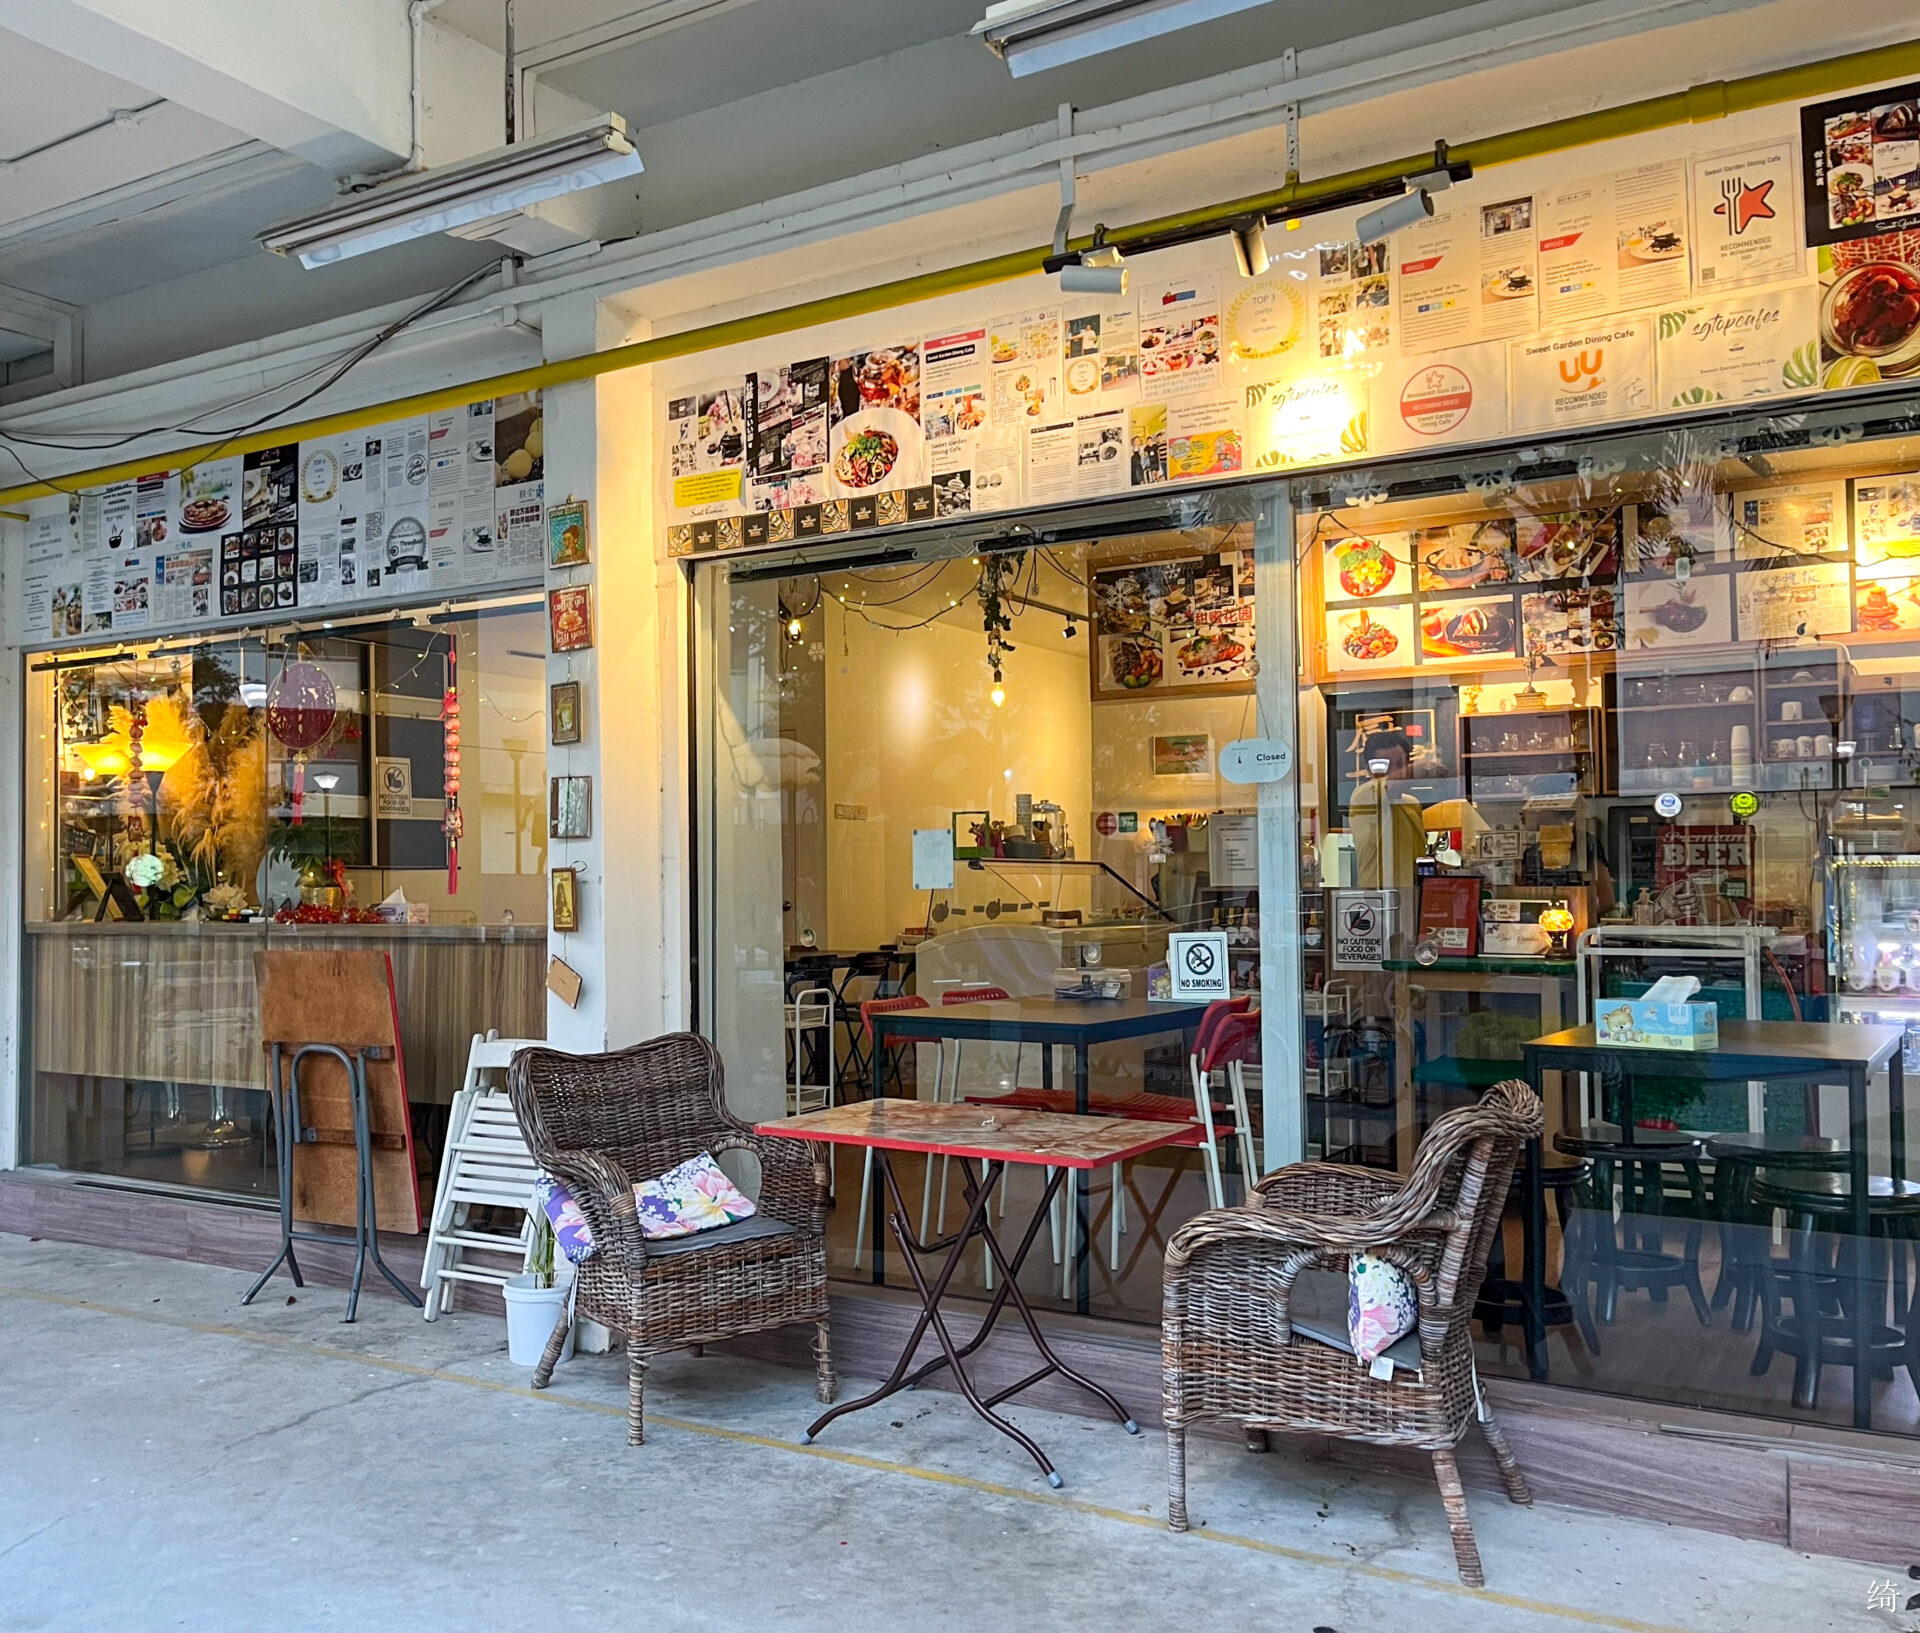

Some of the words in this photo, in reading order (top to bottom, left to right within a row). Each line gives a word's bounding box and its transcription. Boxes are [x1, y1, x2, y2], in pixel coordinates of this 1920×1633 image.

[1705, 168, 1723, 177] Sweet
[1724, 164, 1746, 173] Garden
[1747, 159, 1766, 168] Dining
[1720, 236, 1772, 252] RECOMMENDED
[1252, 295, 1270, 305] TOP
[1270, 294, 1276, 302] 3
[1691, 308, 1780, 342] sgtopcafes
[1526, 344, 1551, 356] Sweet
[1553, 340, 1584, 350] Garden
[1586, 334, 1612, 346] Dining
[1614, 330, 1634, 340] Cafe
[1161, 374, 1182, 382] Garden
[1182, 370, 1200, 380] Dining
[1200, 366, 1214, 375] Cafe
[1407, 390, 1436, 399] Restaurant
[1555, 390, 1608, 406] RECOMMENDED
[1412, 398, 1460, 412] RECOMMENDED
[932, 440, 948, 450] Sweet
[948, 438, 968, 446] Garden
[931, 449, 949, 458] Dining
[565, 506, 584, 515] COFFEE
[1256, 752, 1286, 761] Closed
[1122, 820, 1134, 828] Pay
[1662, 832, 1746, 843] Premium
[1662, 844, 1751, 866] BEER
[1338, 938, 1348, 946] NO
[1350, 938, 1382, 946] OUTSIDE
[1338, 953, 1382, 961] BEVERAGES
[1181, 980, 1190, 988] NO
[1192, 979, 1222, 988] SMOKING
